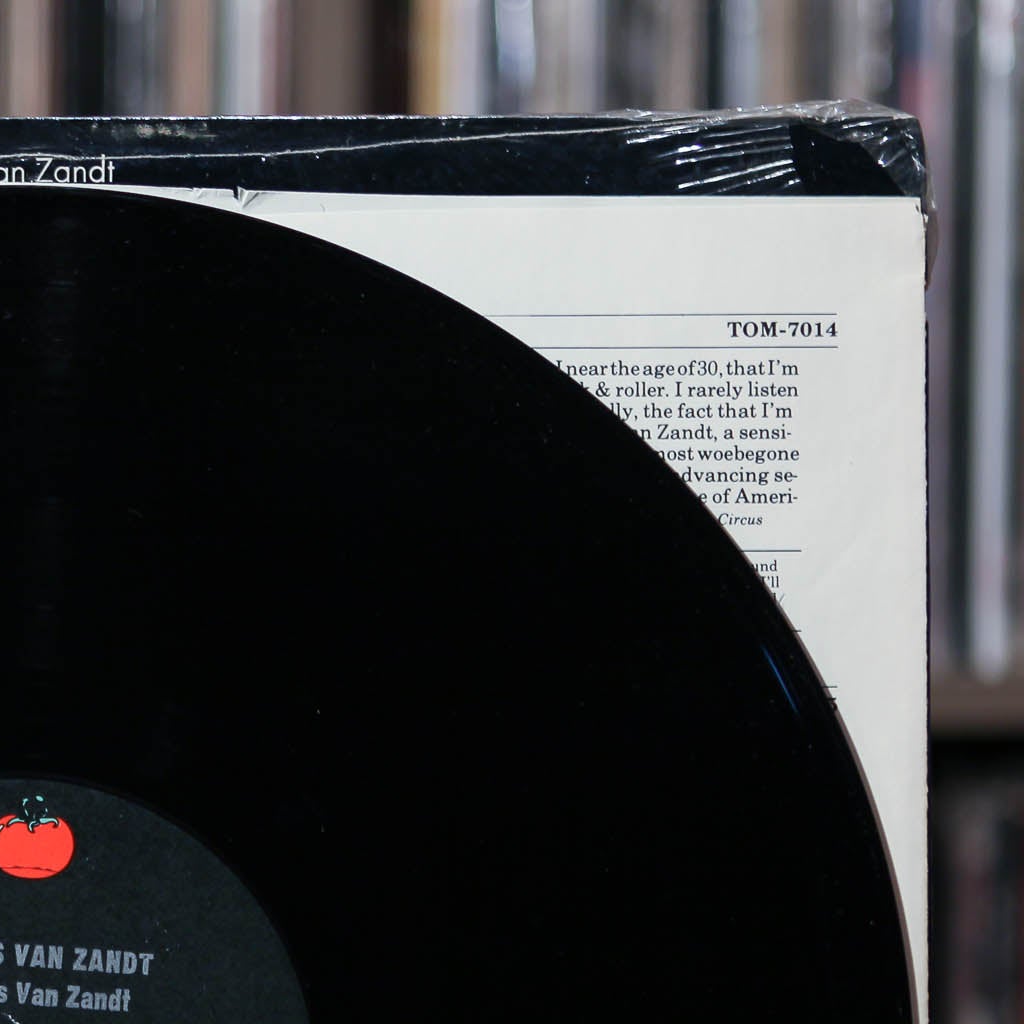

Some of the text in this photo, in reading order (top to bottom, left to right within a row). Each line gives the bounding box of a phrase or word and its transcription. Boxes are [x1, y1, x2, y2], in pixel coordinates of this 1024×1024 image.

[35, 154, 116, 184] Zandt
[727, 321, 838, 338] TOM-7014
[566, 364, 609, 377] near
[610, 360, 640, 376] the
[642, 364, 676, 379] age
[677, 361, 699, 376] of
[699, 361, 723, 379] 30,
[725, 360, 766, 376] that
[767, 360, 800, 376] I'm
[595, 381, 610, 398] &
[616, 381, 669, 397] roller.
[675, 382, 682, 397] I
[688, 381, 743, 400] rarely
[748, 381, 799, 398] listen
[643, 402, 673, 419] the
[677, 402, 714, 419] fact
[718, 402, 757, 419] that
[761, 403, 793, 419] I'm
[657, 424, 718, 442] Zandt,
[723, 428, 735, 440] a
[739, 424, 793, 441] sensi-
[697, 444, 800, 464] woebegone
[773, 473, 799, 483] se-
[712, 488, 732, 504] of
[734, 487, 800, 505] Ameri-
[717, 513, 764, 526] Circus
[14, 943, 64, 970] VAN
[72, 947, 155, 976] ZANDT
[16, 981, 59, 1008] Van
[65, 984, 131, 1013] Zandt
